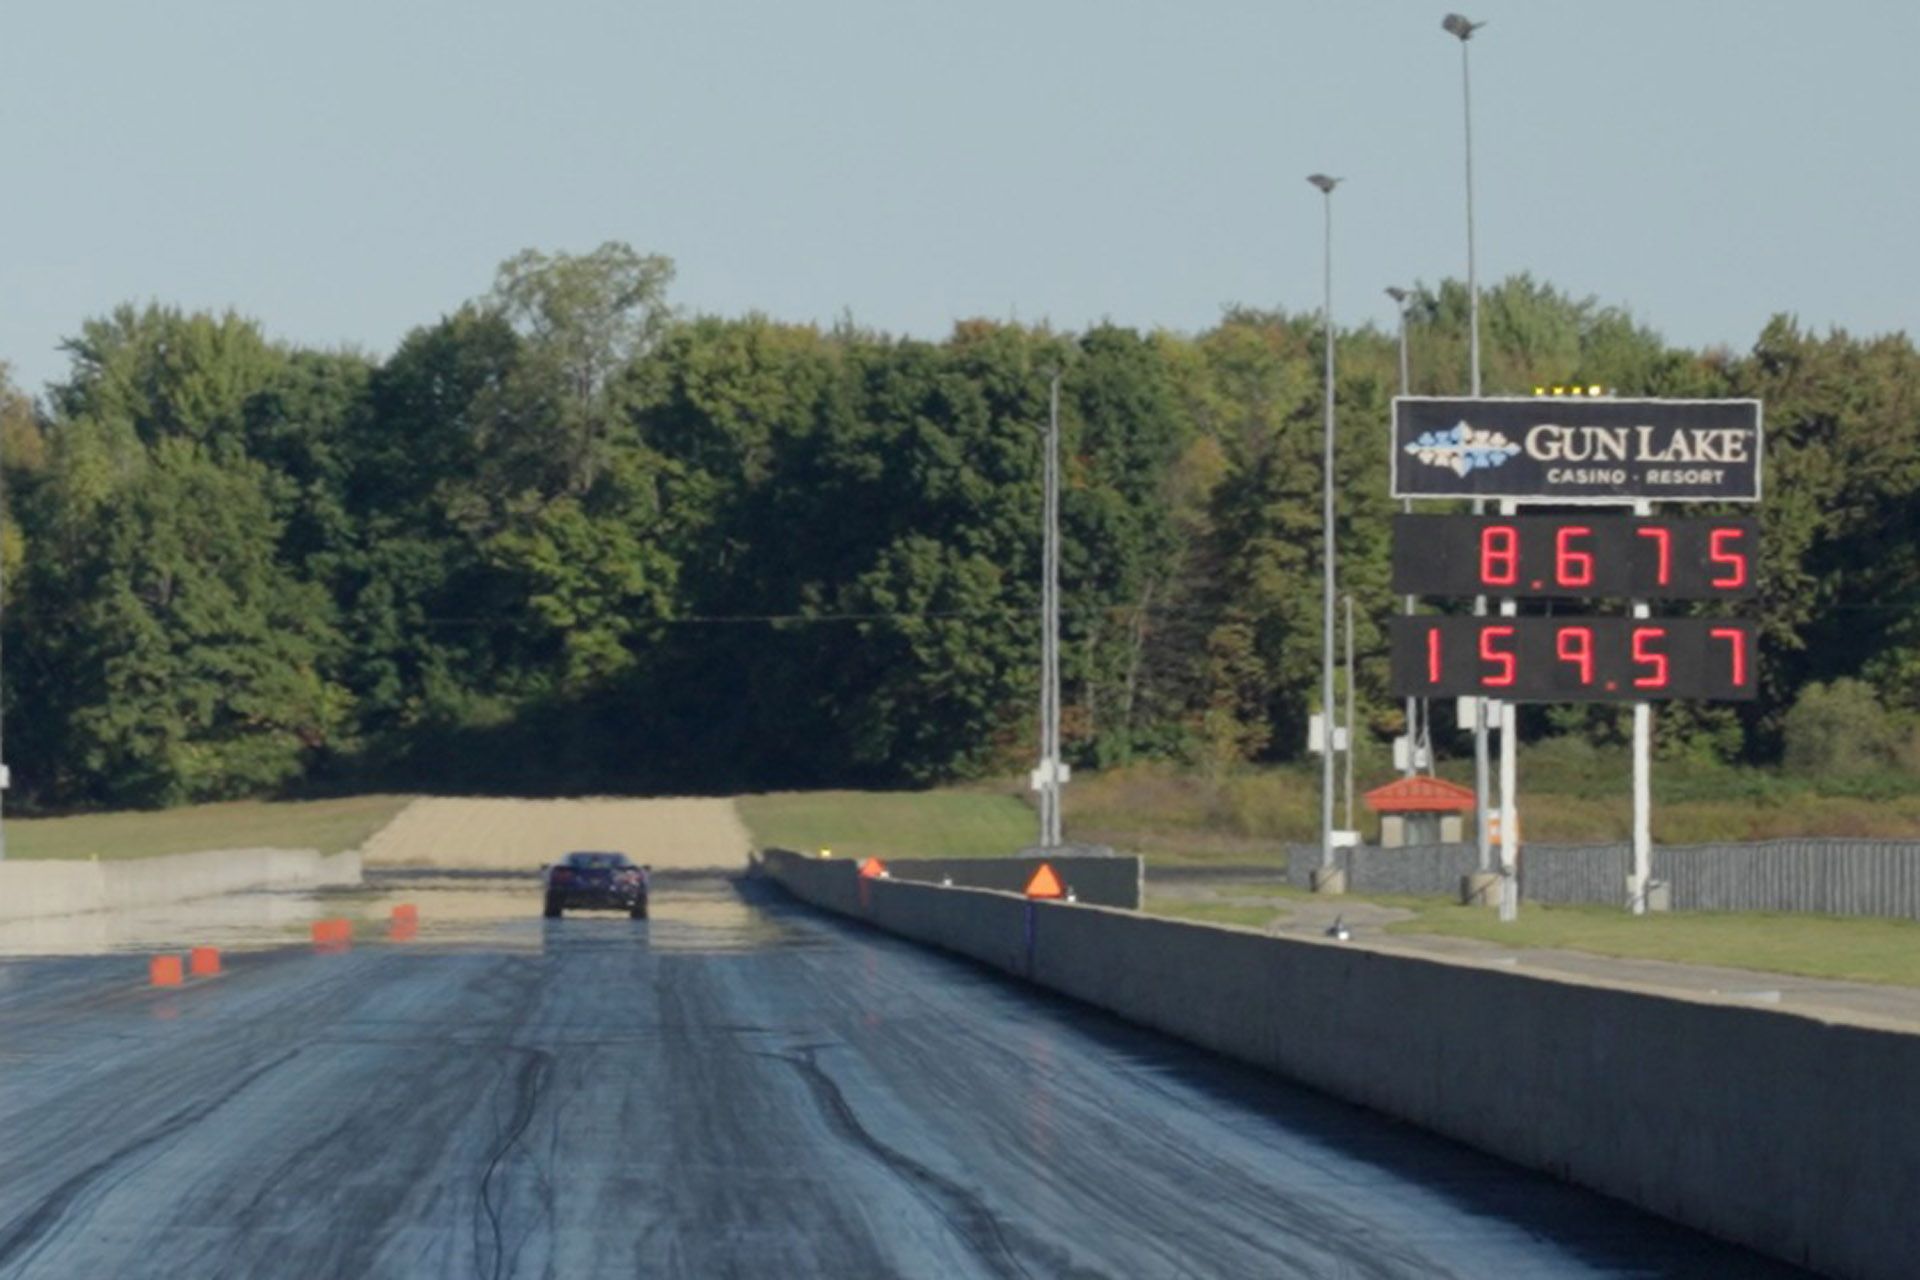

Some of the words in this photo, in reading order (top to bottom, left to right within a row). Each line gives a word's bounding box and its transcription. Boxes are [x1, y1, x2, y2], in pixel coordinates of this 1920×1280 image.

[1525, 423, 1629, 462] GUN
[1635, 425, 1748, 463] LAKE
[1547, 468, 1626, 485] CASINO
[1646, 469, 1725, 485] RESORT
[1479, 526, 1746, 588] 8.675
[1427, 626, 1746, 691] 159.57
